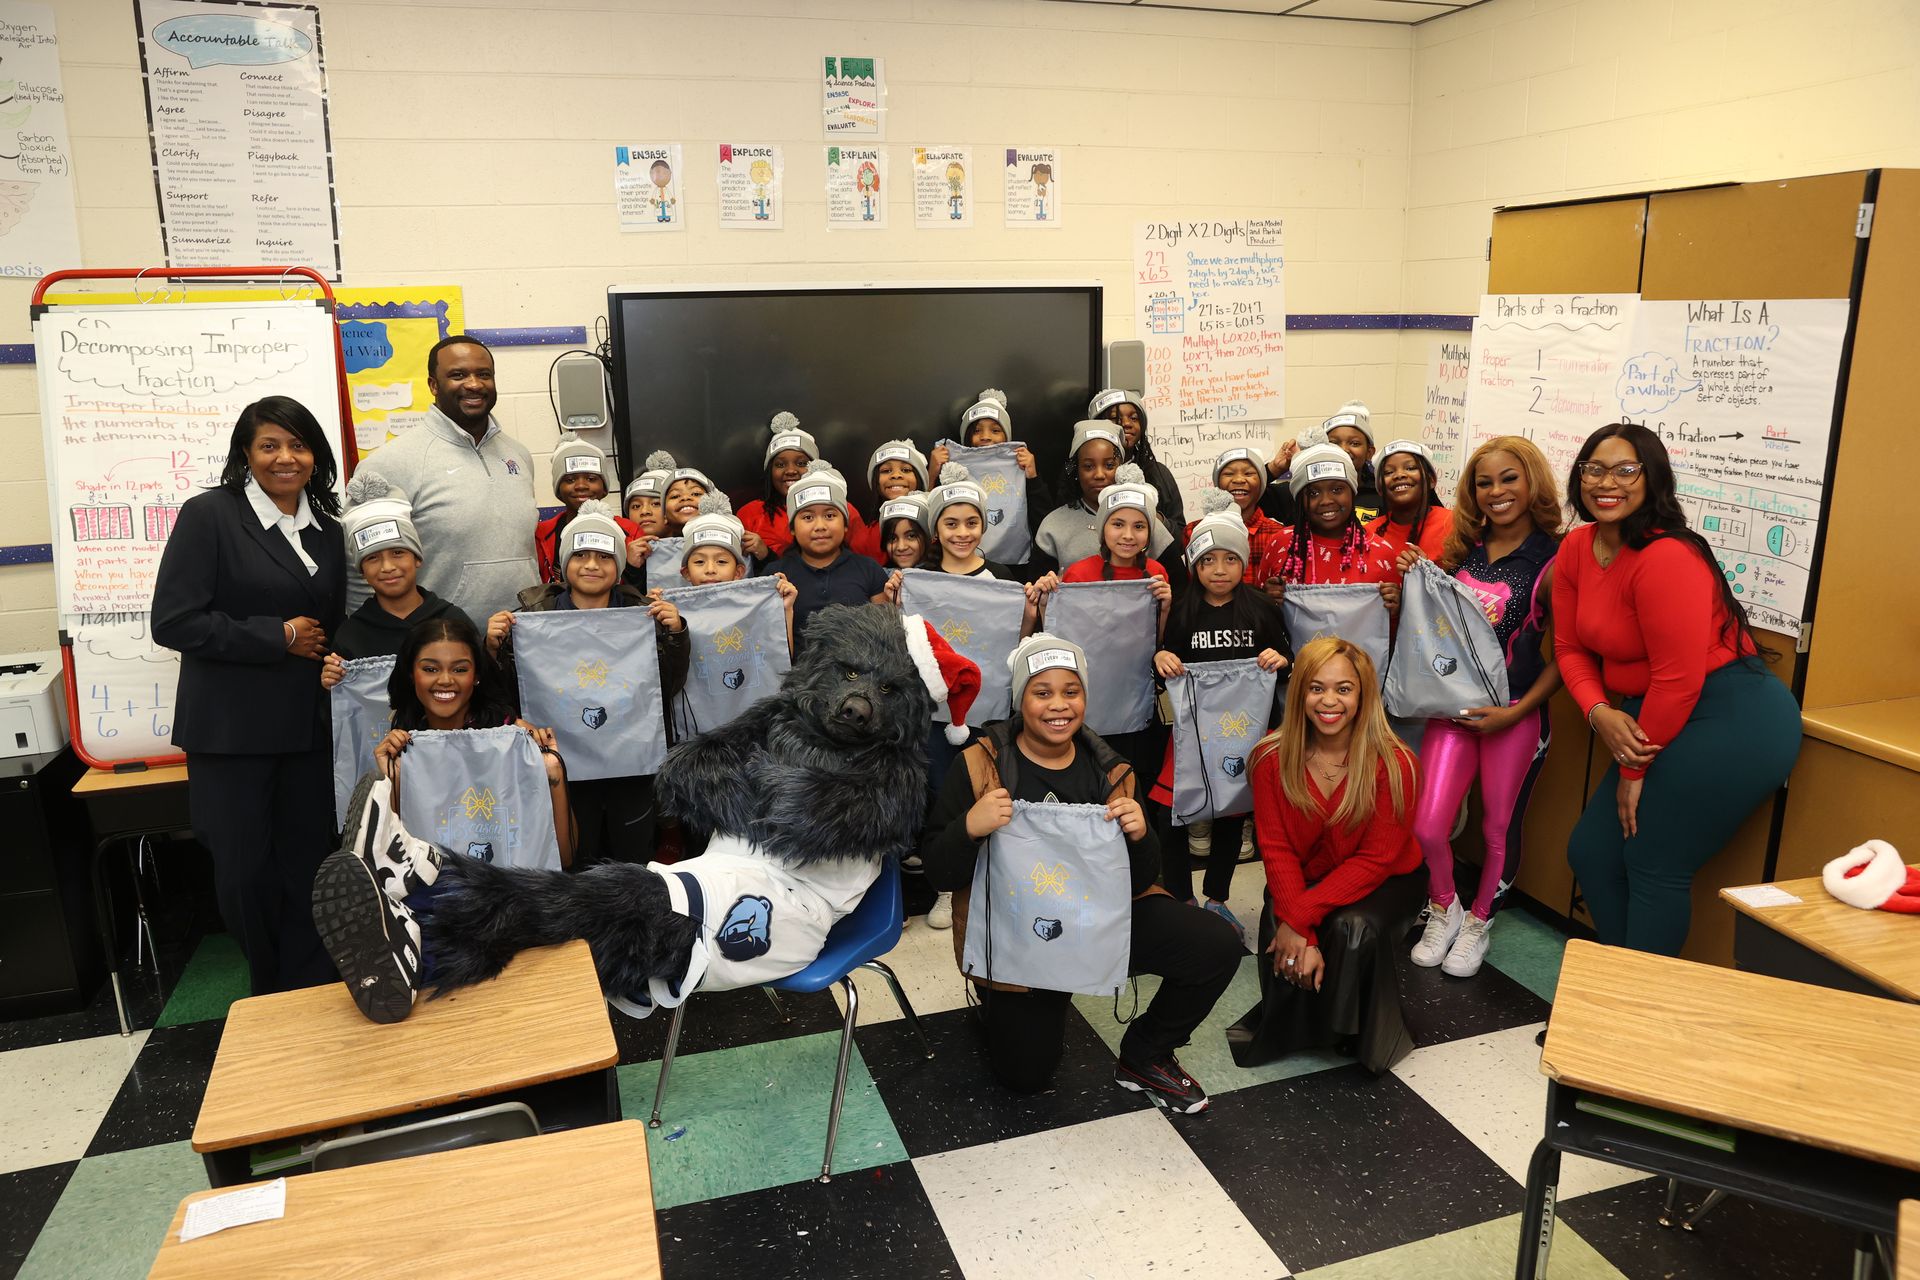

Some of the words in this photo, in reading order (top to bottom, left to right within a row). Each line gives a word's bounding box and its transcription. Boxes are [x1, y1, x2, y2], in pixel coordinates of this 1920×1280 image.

[168, 30, 260, 47] Accountable
[827, 60, 835, 71] 5
[154, 67, 190, 78] Affirm
[240, 72, 284, 82] Connect
[18, 82, 57, 95] Glucose
[848, 97, 877, 109] EXPLORE
[157, 105, 186, 117] Agree
[243, 108, 286, 119] Disagree
[827, 121, 857, 131] EVALUATE
[17, 131, 54, 144] Carbon
[20, 143, 57, 154] Dioxide
[162, 148, 200, 160] Clarify
[733, 148, 772, 158] EXPLORE
[841, 150, 878, 160] EXPLAIN
[248, 151, 299, 163] Piggyback
[632, 150, 668, 161] ENGAGE
[1018, 153, 1054, 162] EVALUATE
[166, 191, 209, 201] Support
[252, 194, 279, 204] Refer
[1250, 220, 1264, 228] Area
[1266, 220, 1284, 228] Model
[1146, 224, 1155, 240] 2
[1158, 222, 1182, 248] Digit
[1188, 222, 1199, 238] X
[1202, 223, 1210, 238] 2
[1214, 221, 1246, 244] Digits
[1263, 227, 1281, 235] Partial
[172, 235, 232, 245] Summarize
[256, 238, 294, 248] Inquire
[1250, 237, 1276, 245] Product
[1146, 250, 1165, 267] 27
[1187, 252, 1208, 266] Since
[1240, 253, 1283, 271] multiplying
[1189, 280, 1209, 290] need
[1211, 278, 1220, 288] to
[1223, 277, 1246, 287] make
[1199, 302, 1213, 317] 27
[1215, 305, 1225, 316] is
[1498, 296, 1527, 317] Parts
[1532, 298, 1544, 315] of
[1554, 304, 1564, 315] a
[1688, 301, 1725, 324] What
[1731, 301, 1752, 324] Is
[1758, 301, 1769, 326] A
[1200, 320, 1213, 333] 65
[1215, 317, 1225, 329] is
[1183, 333, 1218, 350] Multiply
[1262, 329, 1282, 341] then
[61, 331, 195, 373] Decomposing
[201, 333, 299, 364] Improper
[357, 345, 387, 358] Wall
[1216, 344, 1234, 358] then
[1264, 344, 1284, 354] then
[1442, 344, 1470, 370] Multiply
[1483, 349, 1511, 372] Proper
[1693, 355, 1700, 367] A
[1701, 357, 1735, 369] number
[1738, 356, 1764, 368] that
[138, 366, 216, 391] Fraction
[1181, 375, 1204, 390] After
[1247, 366, 1270, 379] found
[1628, 365, 1659, 381] Part
[1662, 368, 1676, 384] of
[1692, 369, 1735, 382] expresses
[1737, 369, 1758, 381] part
[1757, 367, 1770, 381] of
[1179, 388, 1194, 400] the
[1427, 385, 1449, 406] When
[1625, 386, 1635, 395] a
[1708, 382, 1731, 394] whole
[1732, 381, 1758, 397] object
[1529, 386, 1545, 415] 2
[1715, 393, 1726, 403] of
[1727, 394, 1762, 409] objects.
[1180, 408, 1213, 423] Product:
[95, 417, 176, 430] numerator
[187, 421, 200, 430] is
[1197, 424, 1241, 442] Fractions
[1244, 423, 1273, 443] With
[1766, 425, 1788, 438] Part
[63, 435, 88, 445] the
[171, 450, 197, 469] 12
[1784, 460, 1800, 471] have
[110, 482, 121, 491] in
[126, 481, 139, 491] 12
[140, 481, 164, 493] parts
[174, 473, 191, 491] 5
[77, 545, 102, 553] When
[105, 545, 127, 553] one
[131, 543, 160, 553] model
[77, 557, 92, 566] all
[97, 557, 128, 569] parts
[133, 557, 153, 565] are
[75, 570, 102, 579] When
[109, 570, 124, 580] you
[129, 566, 154, 578] have
[117, 592, 150, 602] number
[73, 604, 93, 613] and
[99, 602, 107, 611] a
[111, 602, 144, 614] proper
[92, 685, 110, 710] 4
[98, 716, 118, 738] 6
[153, 713, 171, 737] 6
